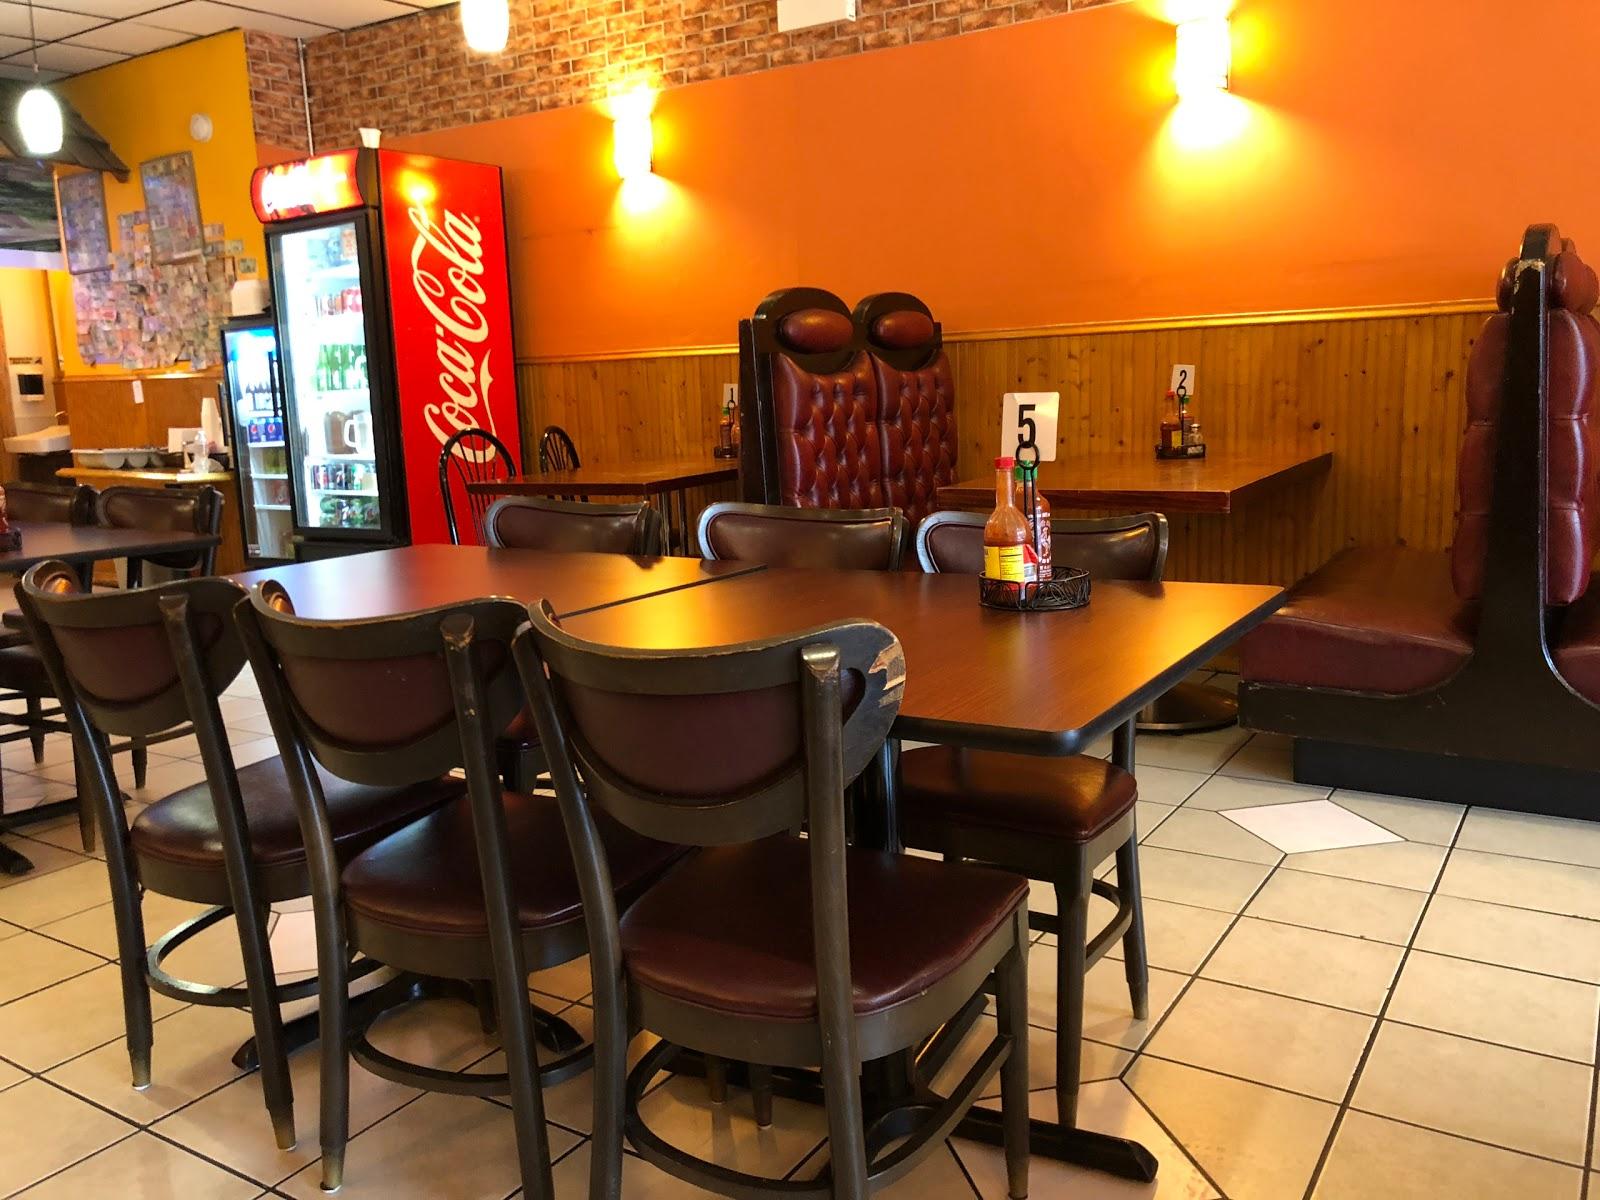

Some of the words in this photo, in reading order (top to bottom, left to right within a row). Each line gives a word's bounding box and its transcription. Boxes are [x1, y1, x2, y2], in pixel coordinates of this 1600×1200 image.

[407, 206, 496, 463] Coca-Cola
[1179, 369, 1188, 389] 2
[1018, 404, 1036, 448] 5
